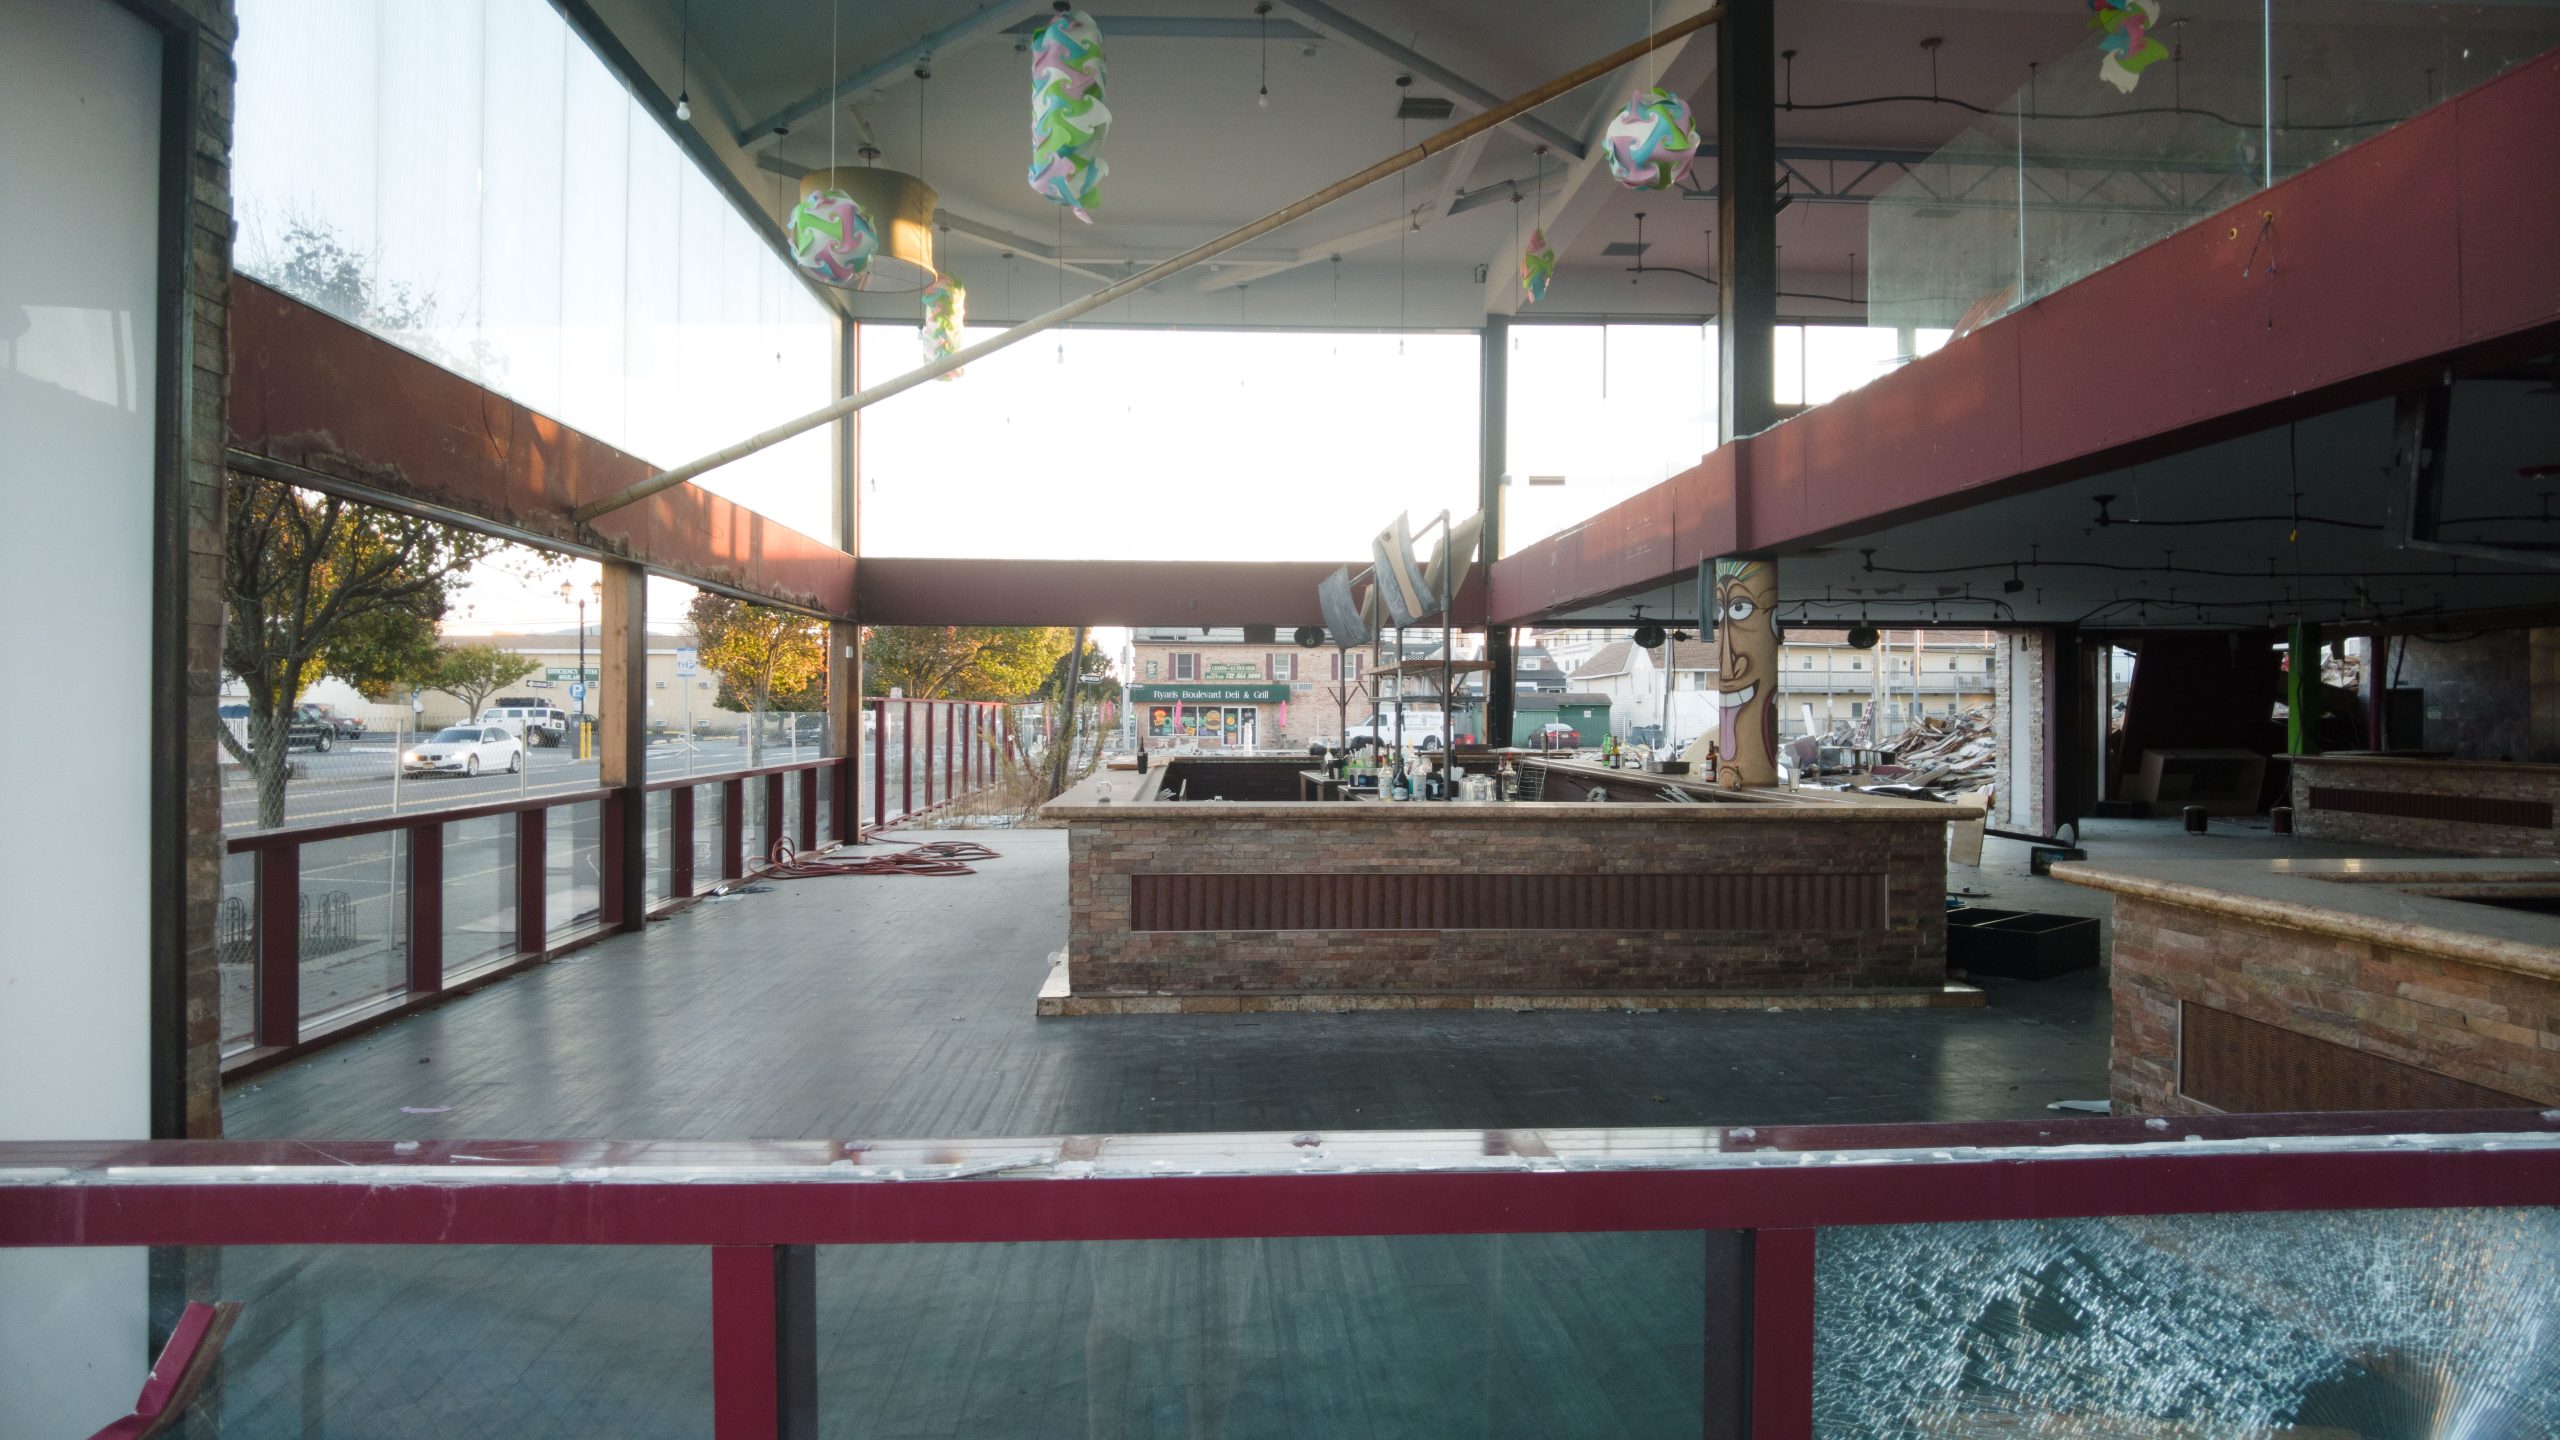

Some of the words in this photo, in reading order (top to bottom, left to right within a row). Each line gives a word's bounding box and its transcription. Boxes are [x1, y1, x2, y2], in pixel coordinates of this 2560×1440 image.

[572, 684, 583, 697] P
[1154, 690, 1179, 700] Ryan's
[1182, 690, 1221, 699] Boulevard
[1225, 690, 1240, 699] Deli
[1243, 691, 1250, 699] &
[1253, 690, 1269, 699] Grill
